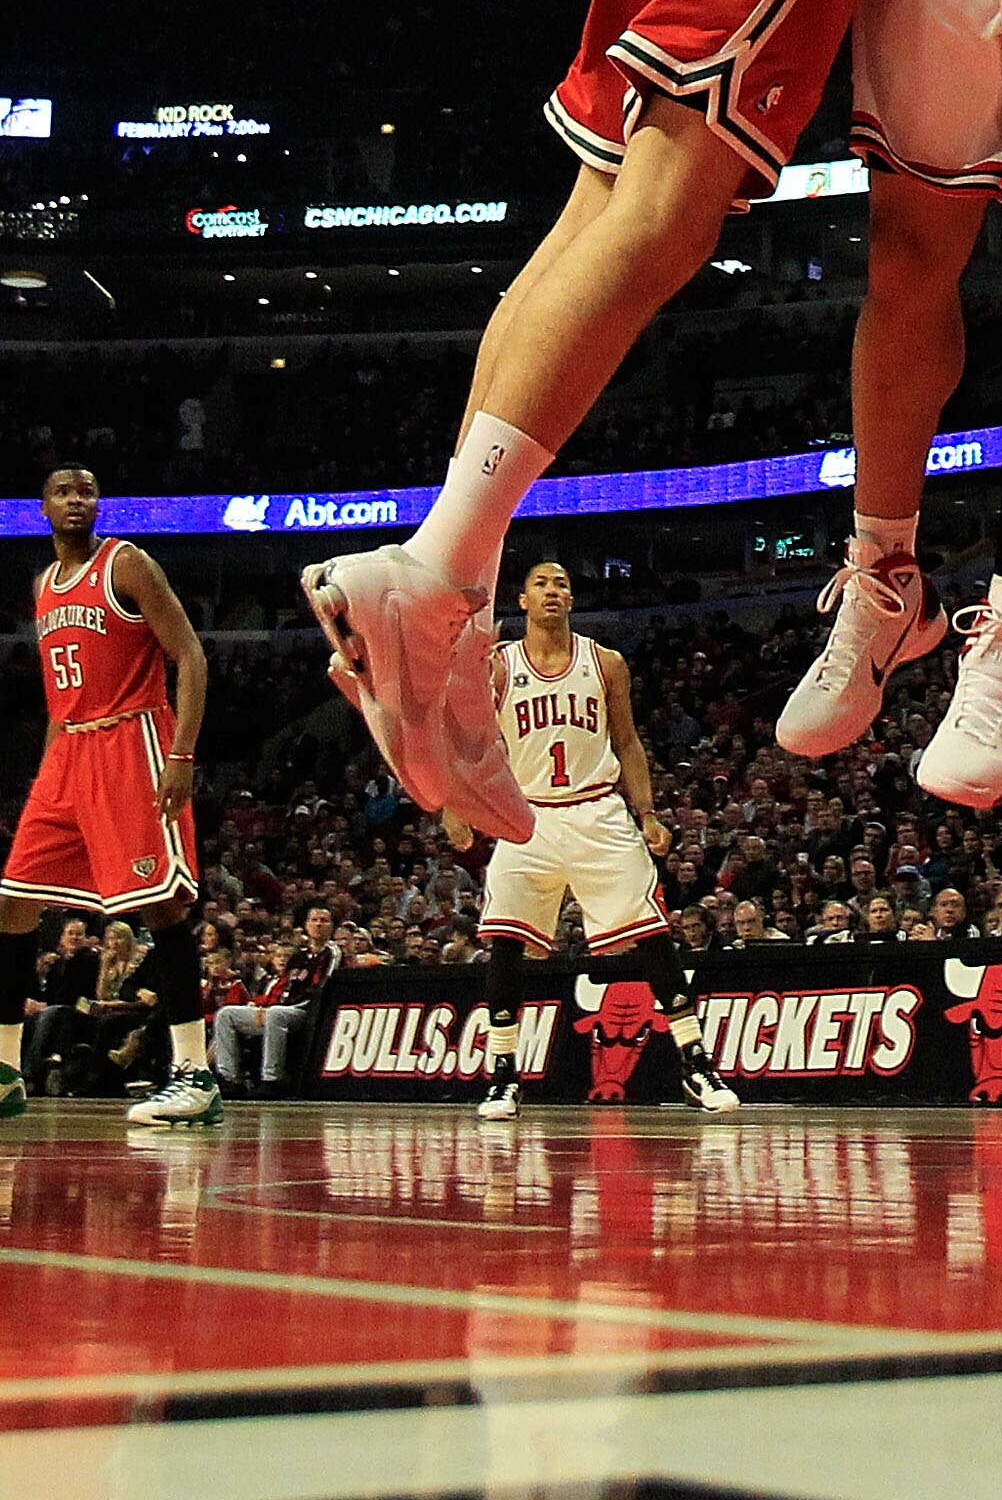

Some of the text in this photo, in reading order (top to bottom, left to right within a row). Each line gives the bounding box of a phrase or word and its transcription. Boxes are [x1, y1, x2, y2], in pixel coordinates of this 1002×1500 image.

[157, 104, 234, 122] KID ROCK
[117, 121, 192, 138] FEBRUARY
[189, 208, 260, 227] comcast
[304, 202, 508, 229] CSNCHICAGO.COM
[203, 223, 269, 239] SPORTSNET
[285, 496, 398, 527] Abt.com
[49, 643, 83, 690] 55
[513, 692, 599, 739] BULLS
[549, 740, 570, 788] 1
[324, 1004, 560, 1074] BULLS.CM
[700, 989, 916, 1072] TICKETS
